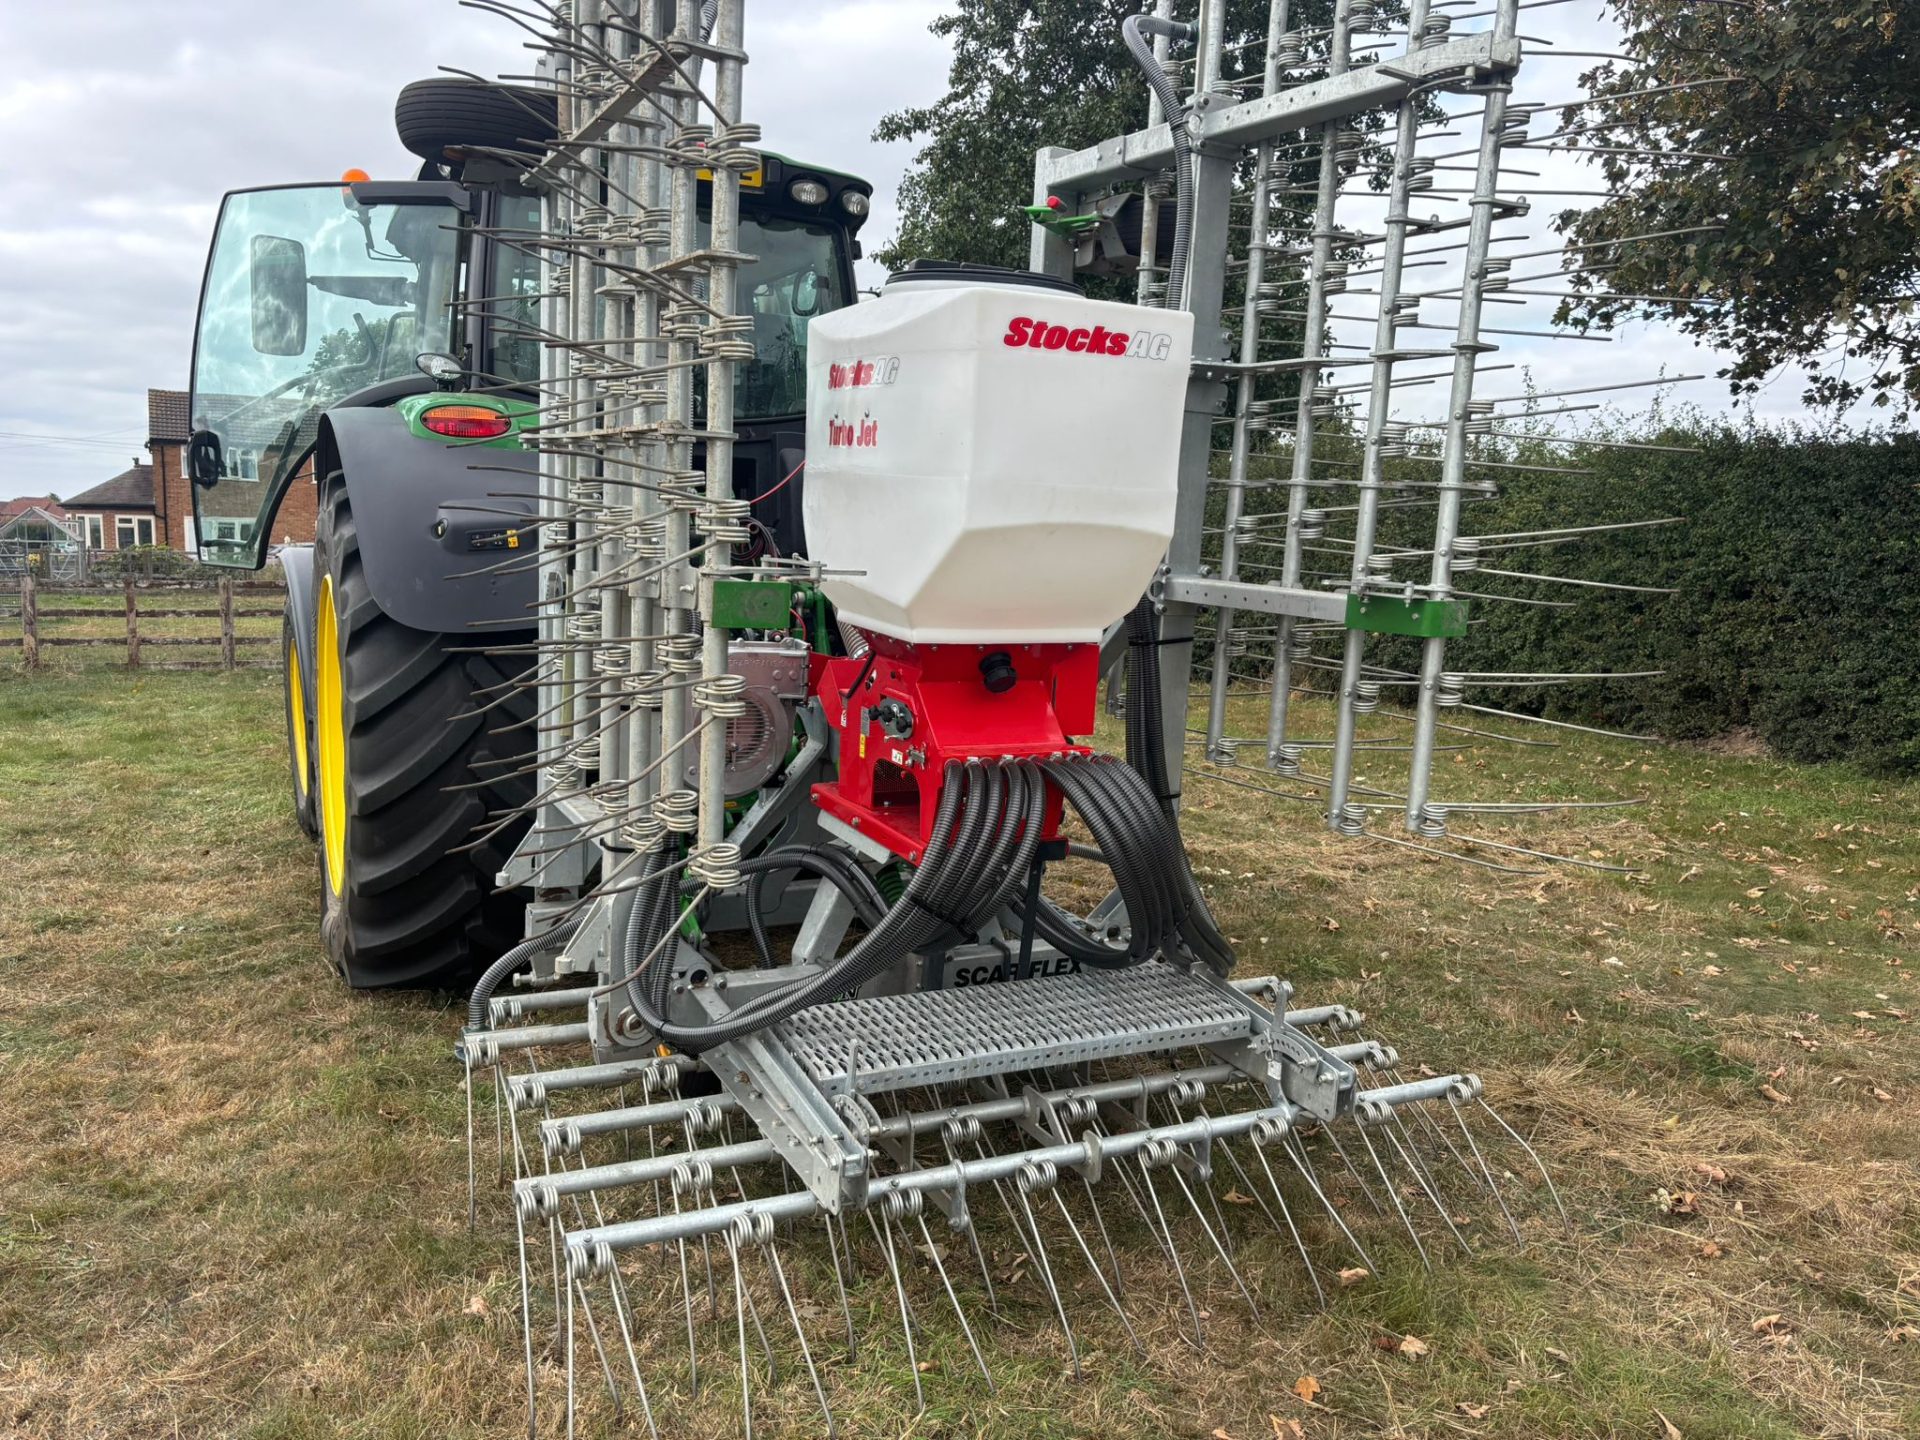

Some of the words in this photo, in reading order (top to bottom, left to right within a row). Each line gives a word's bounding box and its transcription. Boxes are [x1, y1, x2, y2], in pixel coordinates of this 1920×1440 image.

[829, 419, 854, 446] Turbo
[857, 418, 878, 446] Jet
[954, 957, 1082, 988] SCARFLEX
